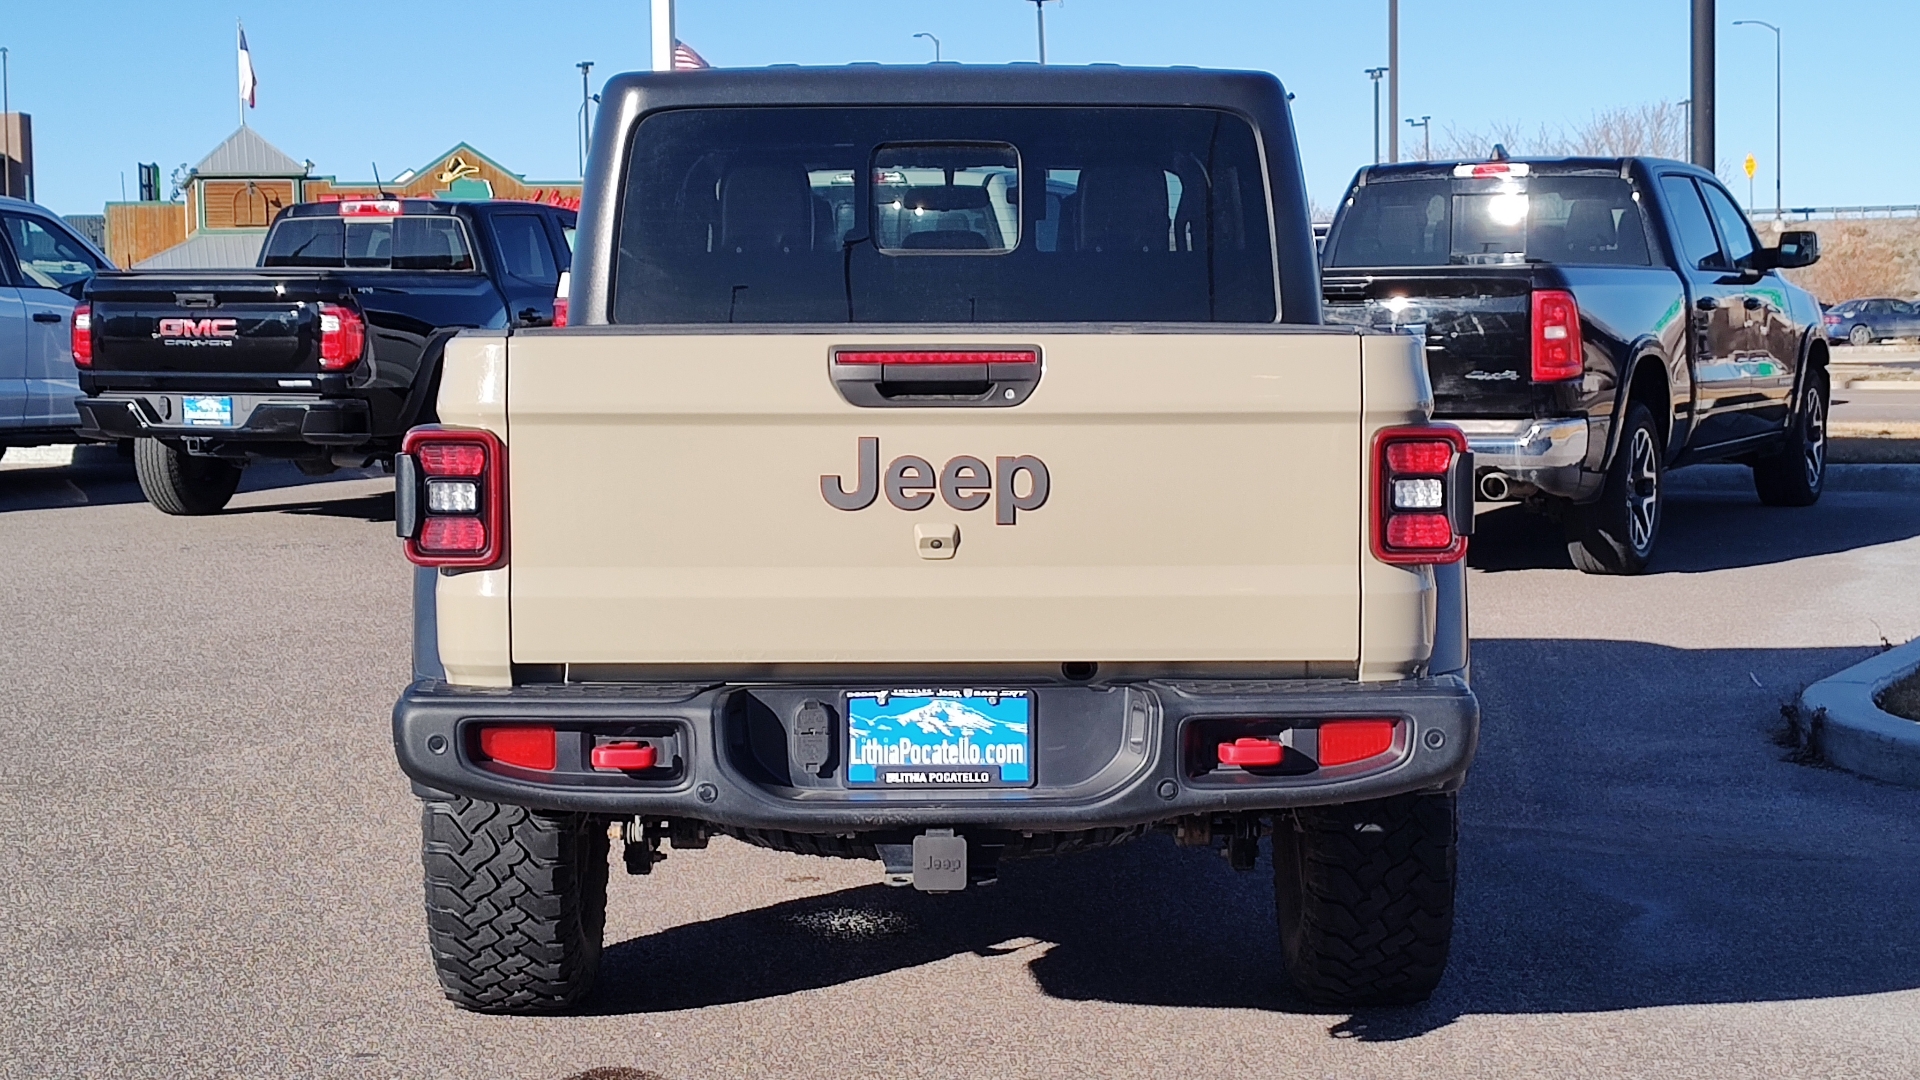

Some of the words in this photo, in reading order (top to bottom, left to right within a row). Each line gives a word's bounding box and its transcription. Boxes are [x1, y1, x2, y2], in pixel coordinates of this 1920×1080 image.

[159, 318, 237, 338] GMC
[163, 339, 233, 347] CANYON
[820, 436, 1051, 526] Jeep
[850, 736, 1024, 765] LithiaPocatello.com
[929, 772, 990, 783] POCATELLO
[923, 855, 961, 873] Jeep
